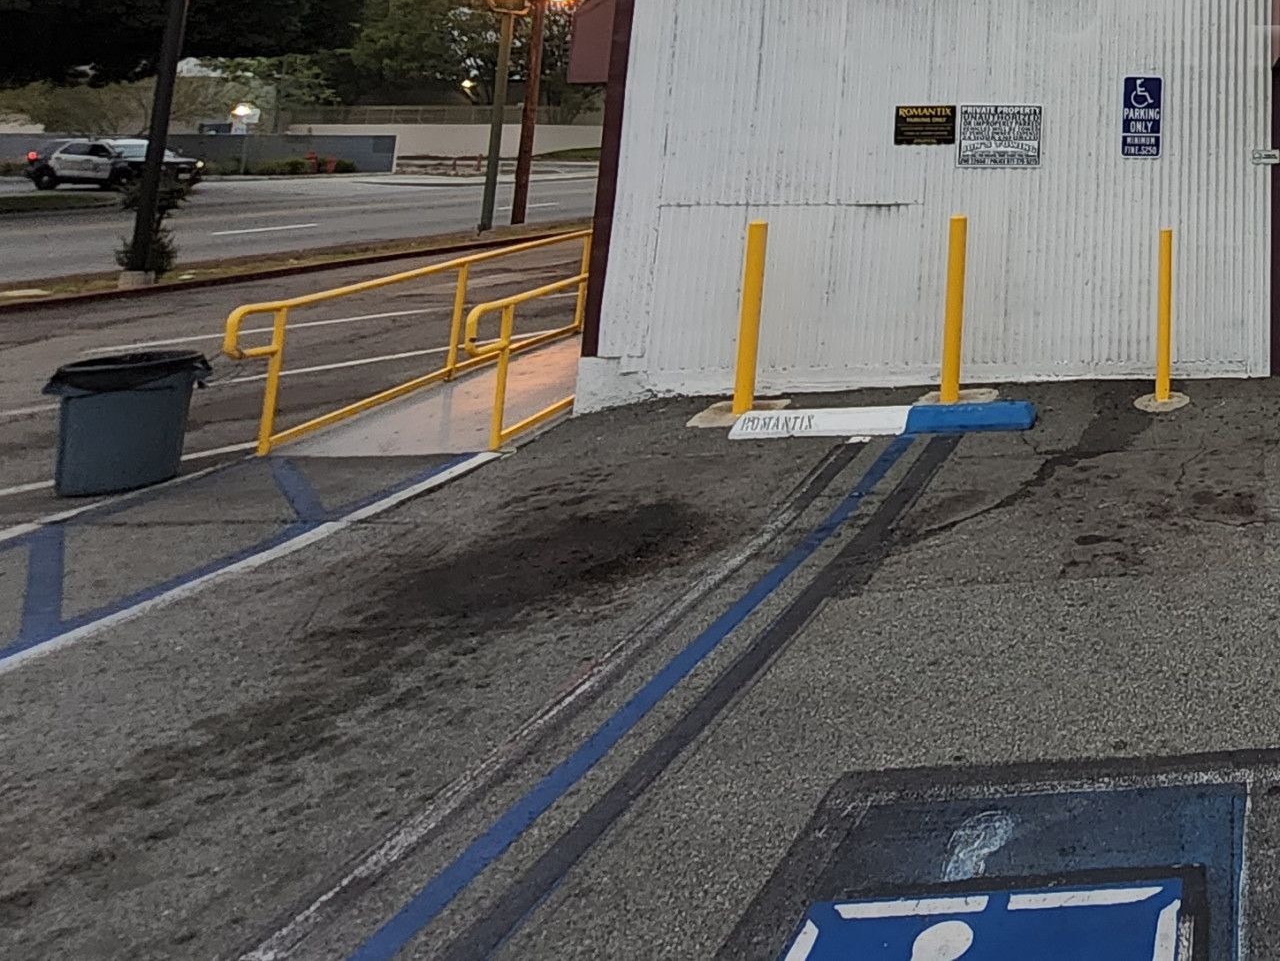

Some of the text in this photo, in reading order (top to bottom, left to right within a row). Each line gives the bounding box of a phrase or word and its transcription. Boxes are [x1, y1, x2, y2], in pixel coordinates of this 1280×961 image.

[899, 107, 951, 117] ROMANTIX
[962, 106, 1040, 114] PRIVATE PROPERTY
[1124, 108, 1160, 119] PARKING
[1130, 121, 1153, 133] ONLY
[742, 415, 814, 433] ROMANTIX
